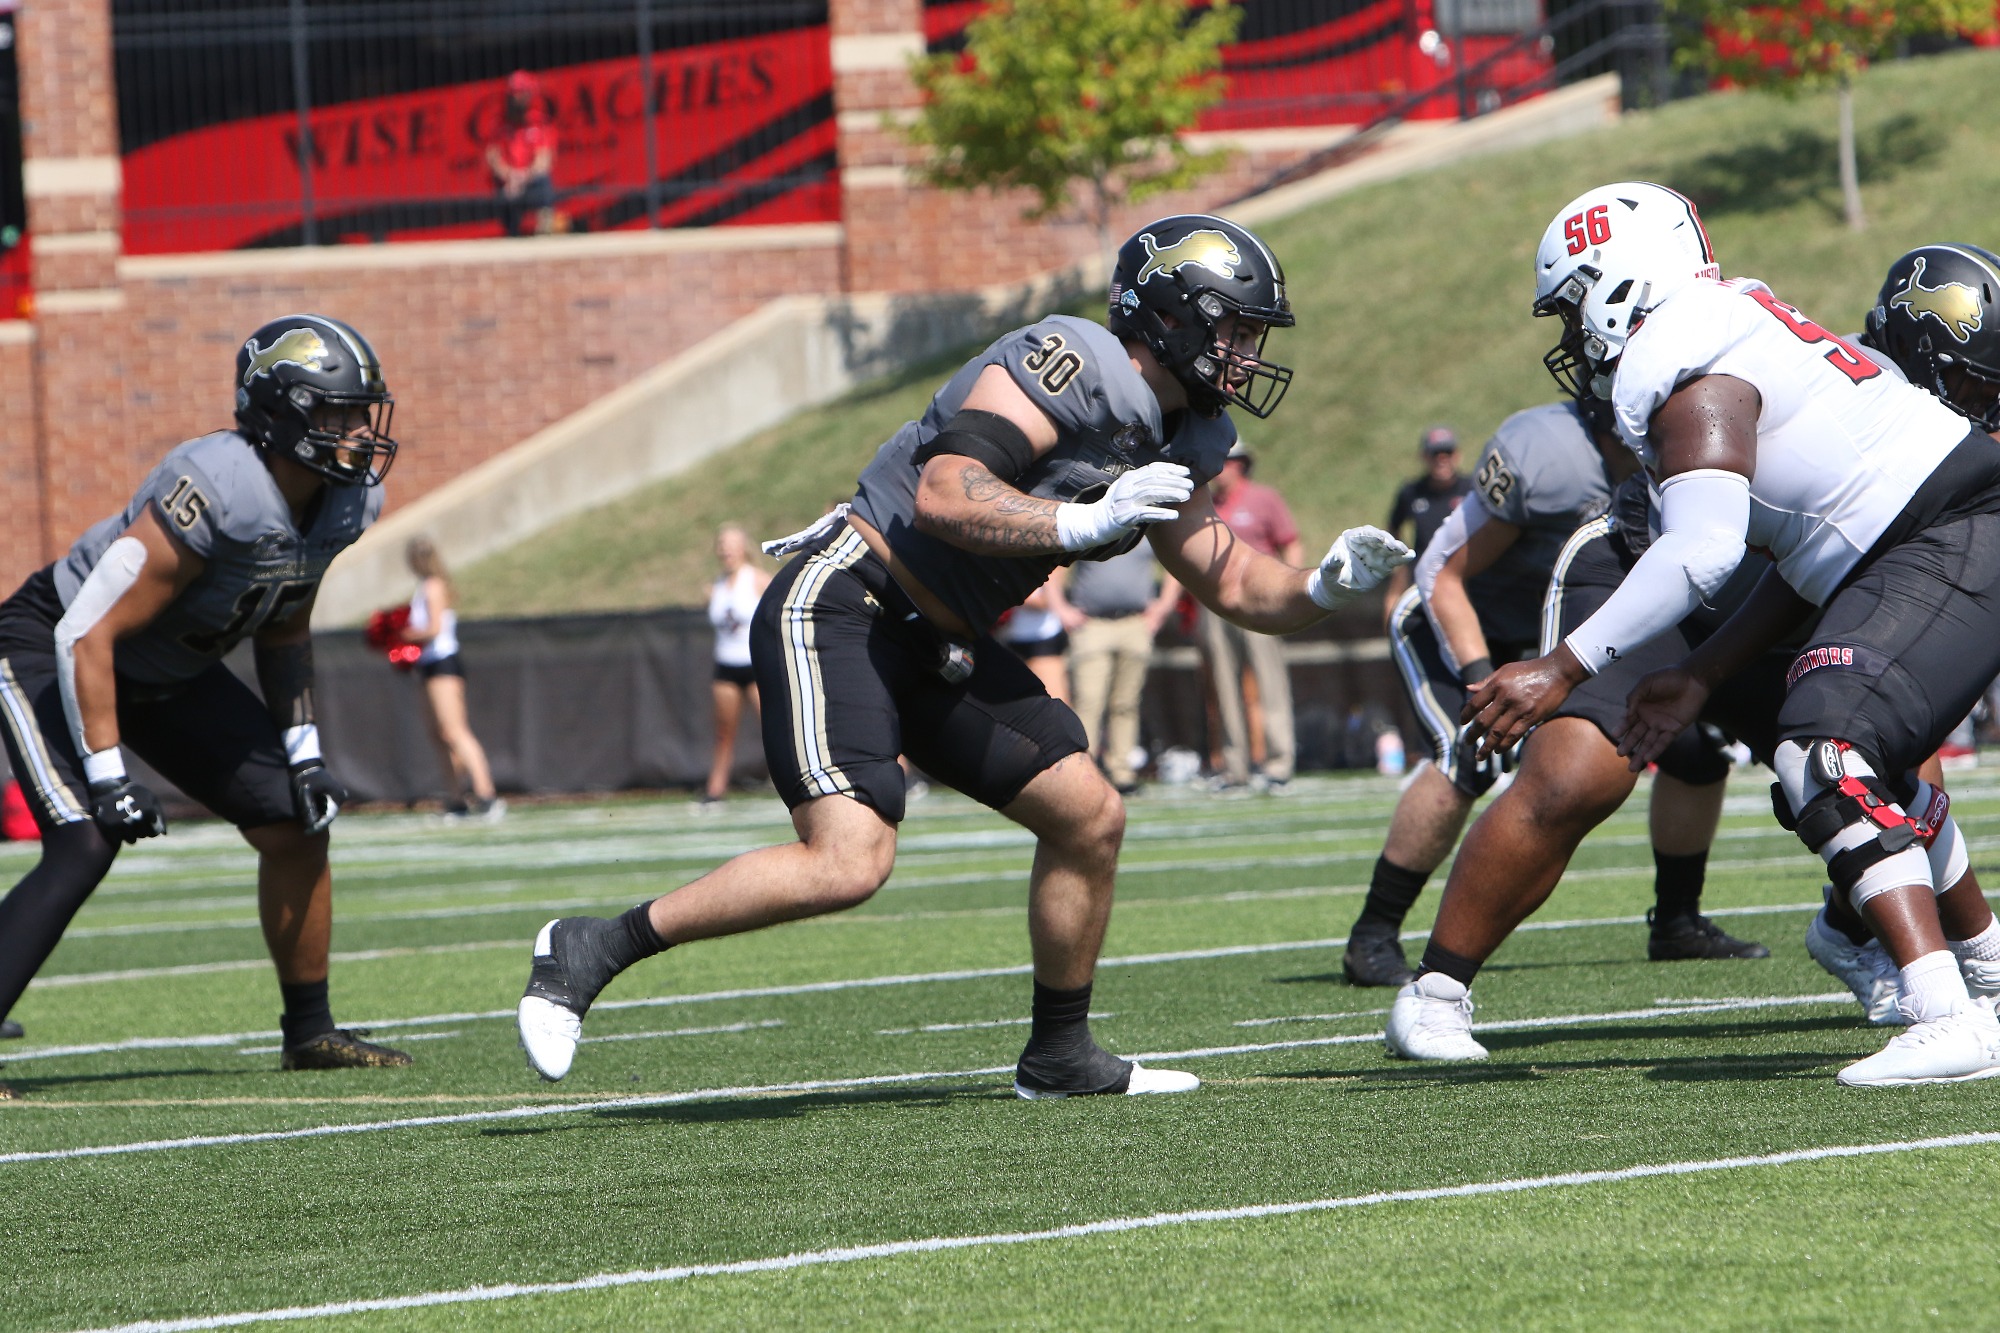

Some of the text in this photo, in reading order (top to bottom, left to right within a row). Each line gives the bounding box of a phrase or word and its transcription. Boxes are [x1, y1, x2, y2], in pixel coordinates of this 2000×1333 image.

[284, 104, 442, 169] WISE
[1564, 204, 1612, 257] 56
[1022, 332, 1084, 397] 30
[160, 475, 210, 532] 15
[1475, 447, 1516, 508] 52
